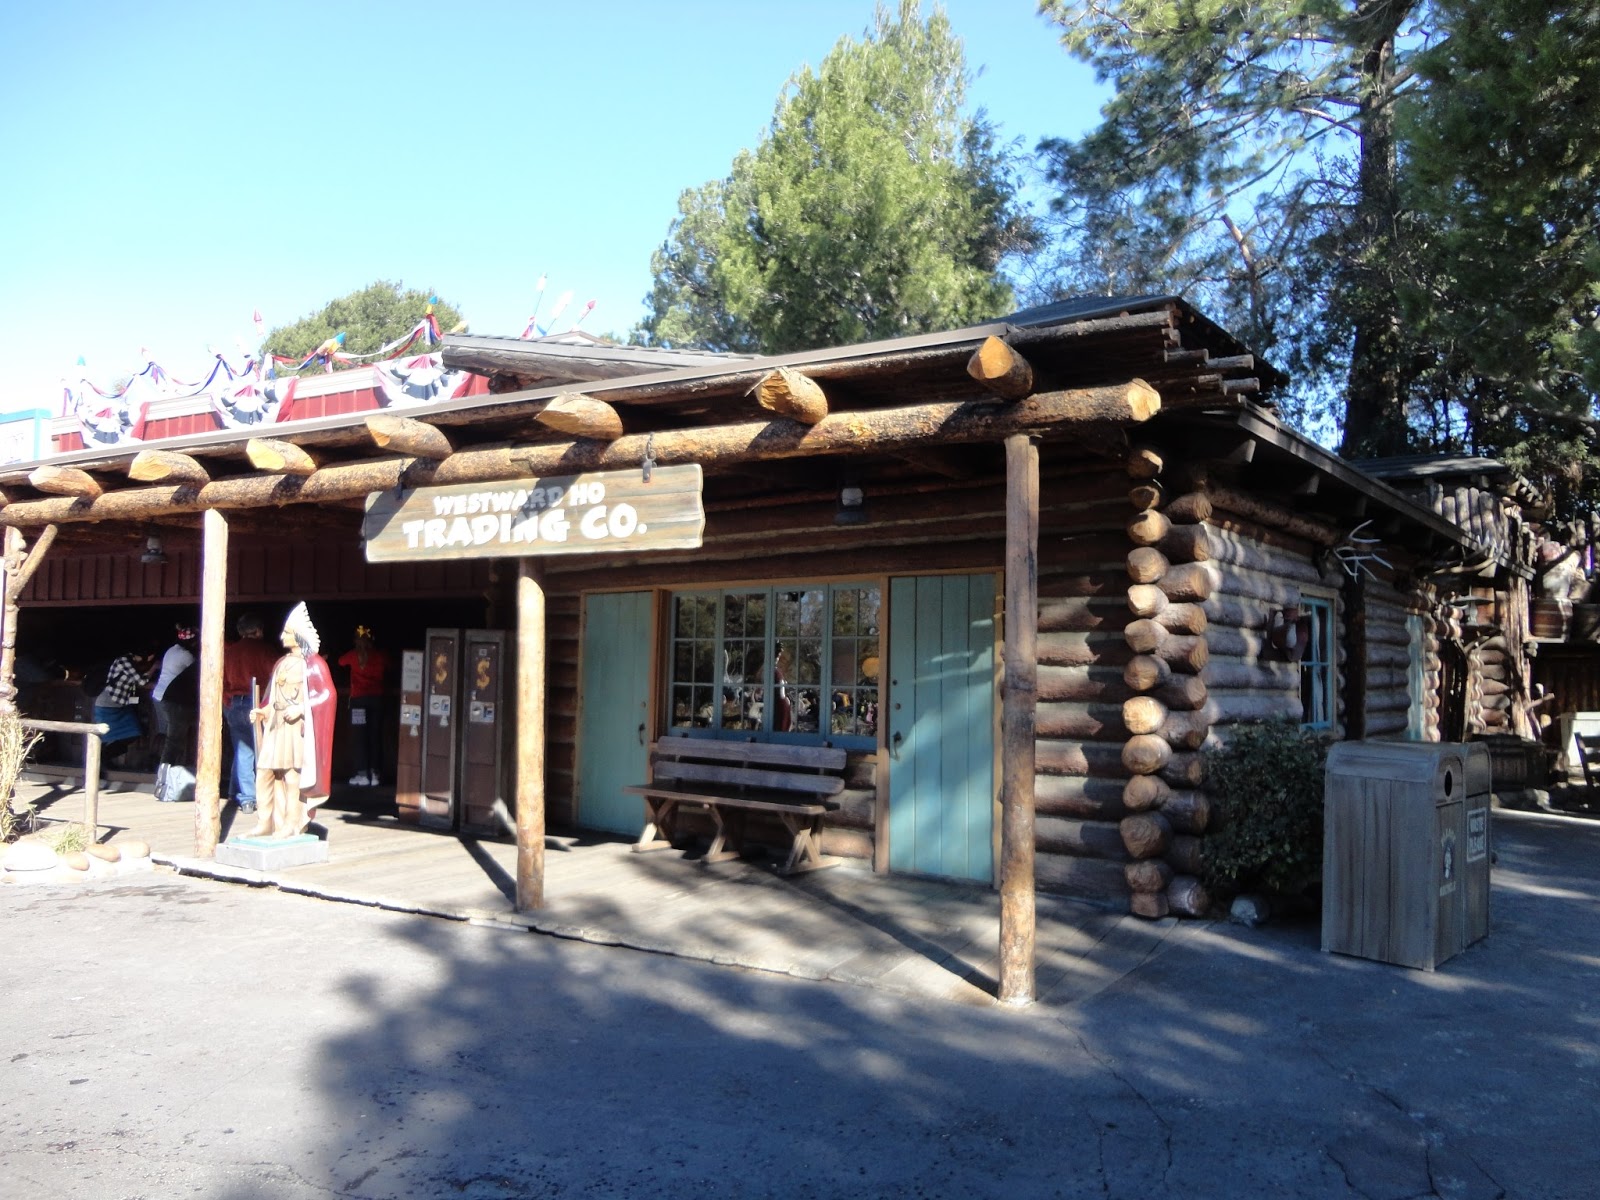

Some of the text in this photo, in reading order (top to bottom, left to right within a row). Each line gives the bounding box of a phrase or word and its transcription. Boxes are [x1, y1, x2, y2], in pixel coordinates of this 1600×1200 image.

[432, 482, 606, 516] WESTWARD HO
[402, 503, 648, 549] TRADING CO.
